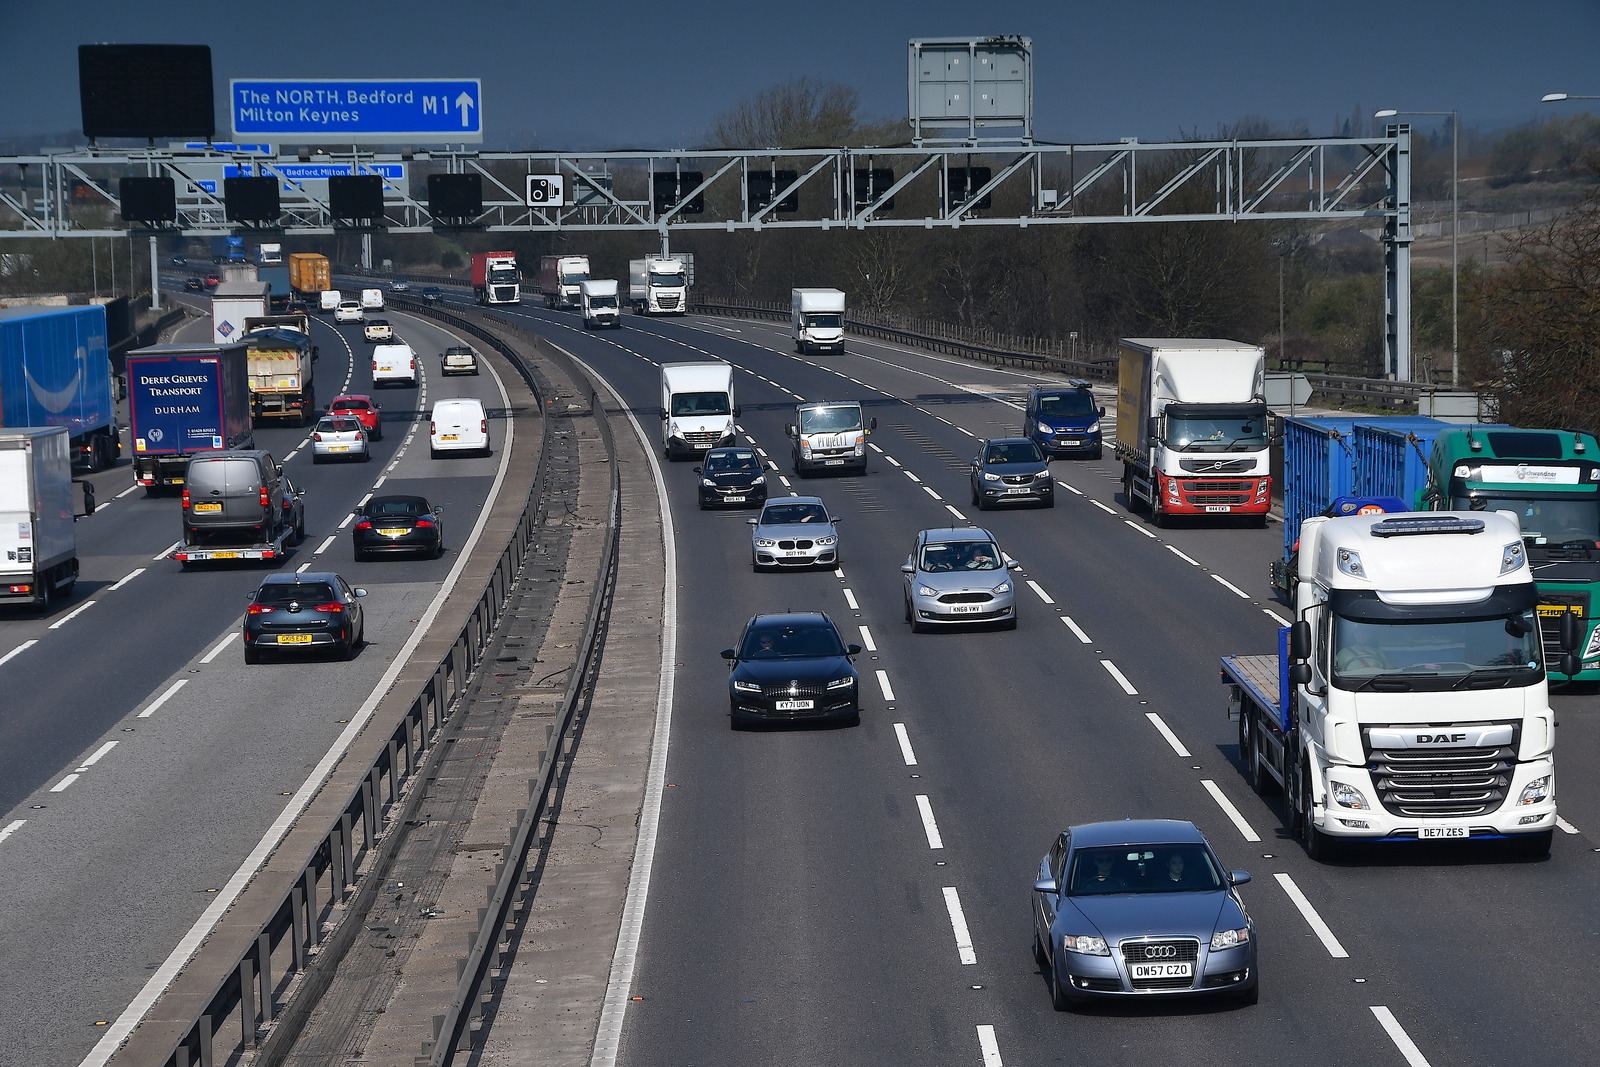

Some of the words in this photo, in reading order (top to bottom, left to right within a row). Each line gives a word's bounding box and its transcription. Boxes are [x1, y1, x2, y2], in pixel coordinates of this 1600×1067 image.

[239, 89, 270, 104] The
[347, 89, 414, 104] Bedford
[239, 107, 294, 122] Milton
[299, 108, 360, 124] Keynes
[321, 168, 346, 177] Milton
[140, 375, 171, 385] DEREK
[171, 374, 208, 384] GRIEVES
[148, 387, 202, 396] TRANSPORT
[154, 405, 200, 415] DURHAM
[1416, 733, 1467, 744] DAF
[1423, 828, 1445, 837] DE71
[1446, 828, 1464, 836] ZES
[1136, 965, 1164, 976] OW57
[1166, 964, 1188, 975] CZO
